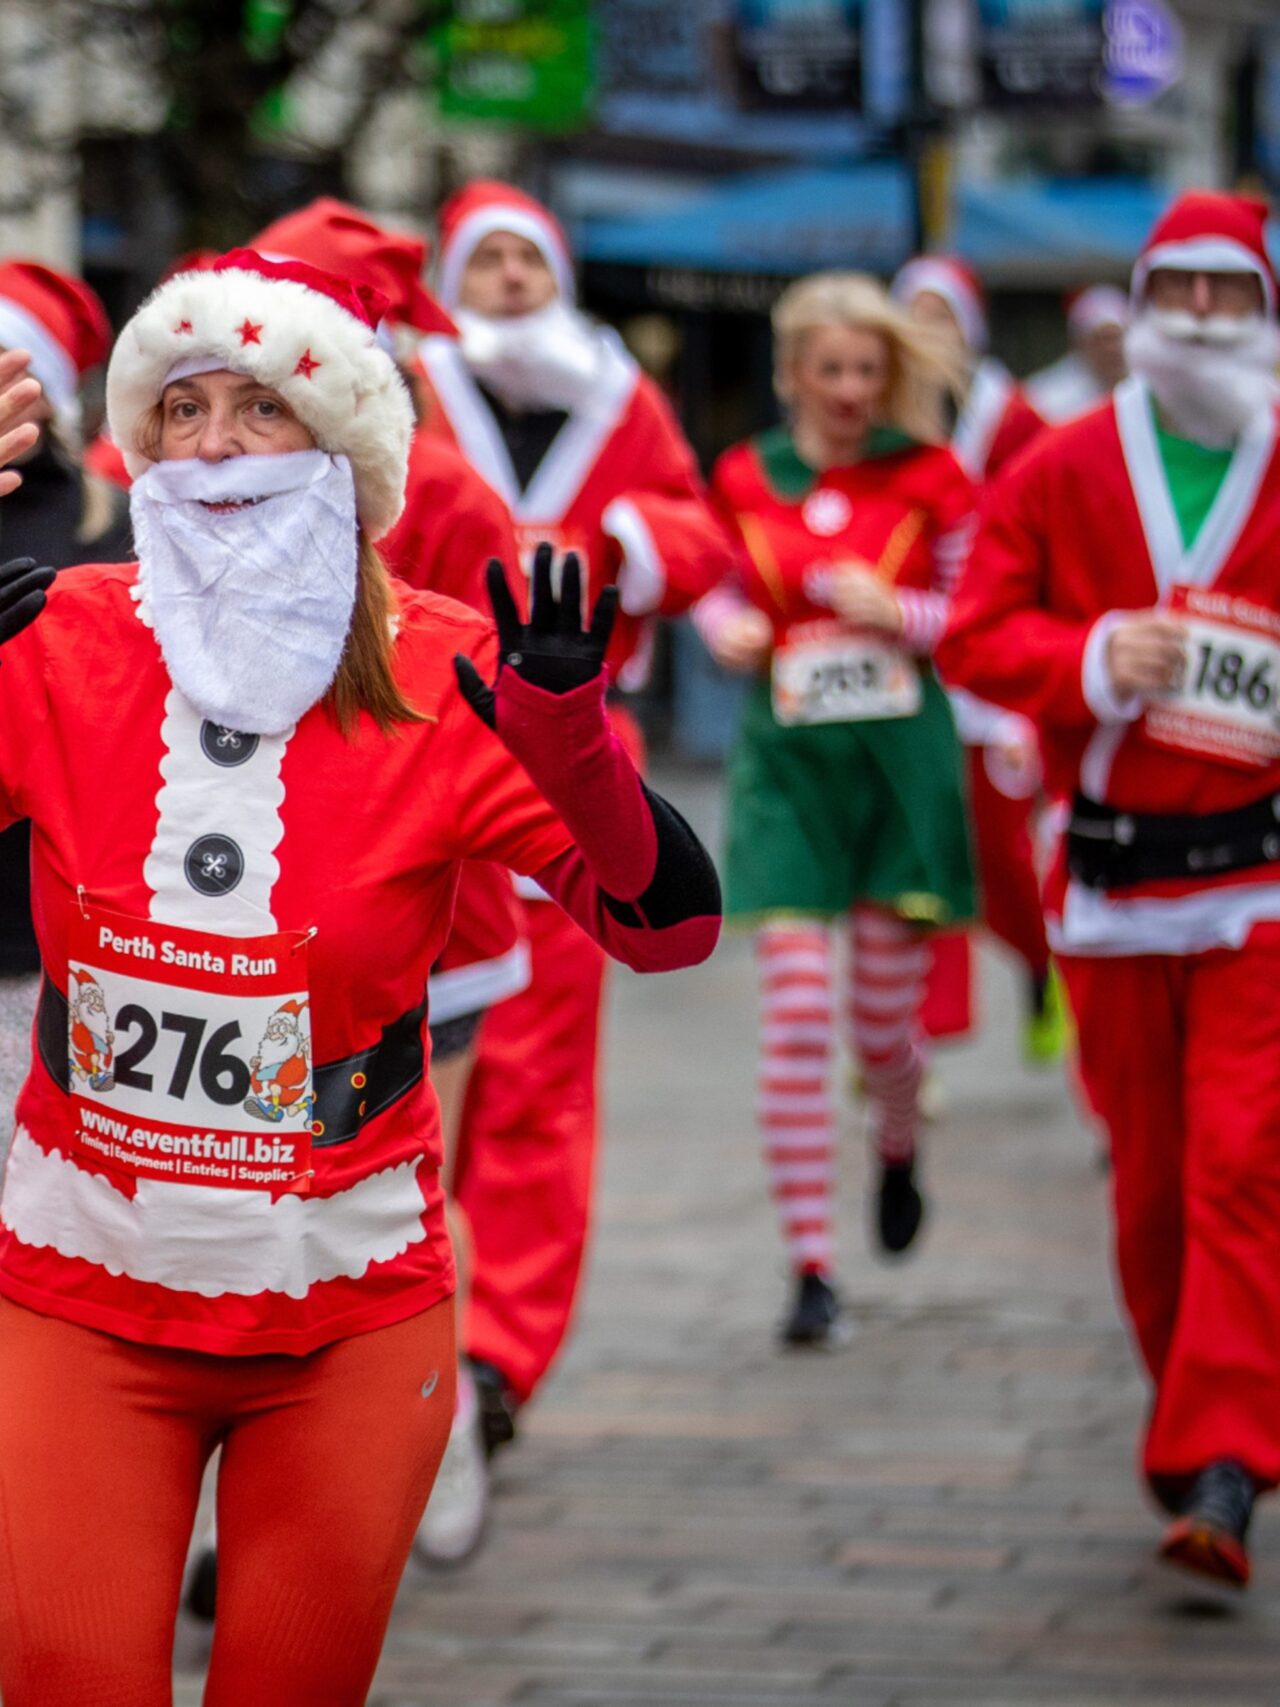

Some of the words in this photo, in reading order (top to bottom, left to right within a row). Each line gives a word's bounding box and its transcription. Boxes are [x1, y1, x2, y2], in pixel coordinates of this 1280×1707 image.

[1196, 642, 1271, 709] 186
[99, 926, 156, 960] Perth
[160, 940, 225, 974] Santa
[231, 954, 277, 976] Run
[114, 1003, 251, 1106] 276
[80, 1107, 295, 1163] www.eventfull.biz
[114, 1147, 174, 1172] Equipment
[183, 1161, 229, 1178] Entries
